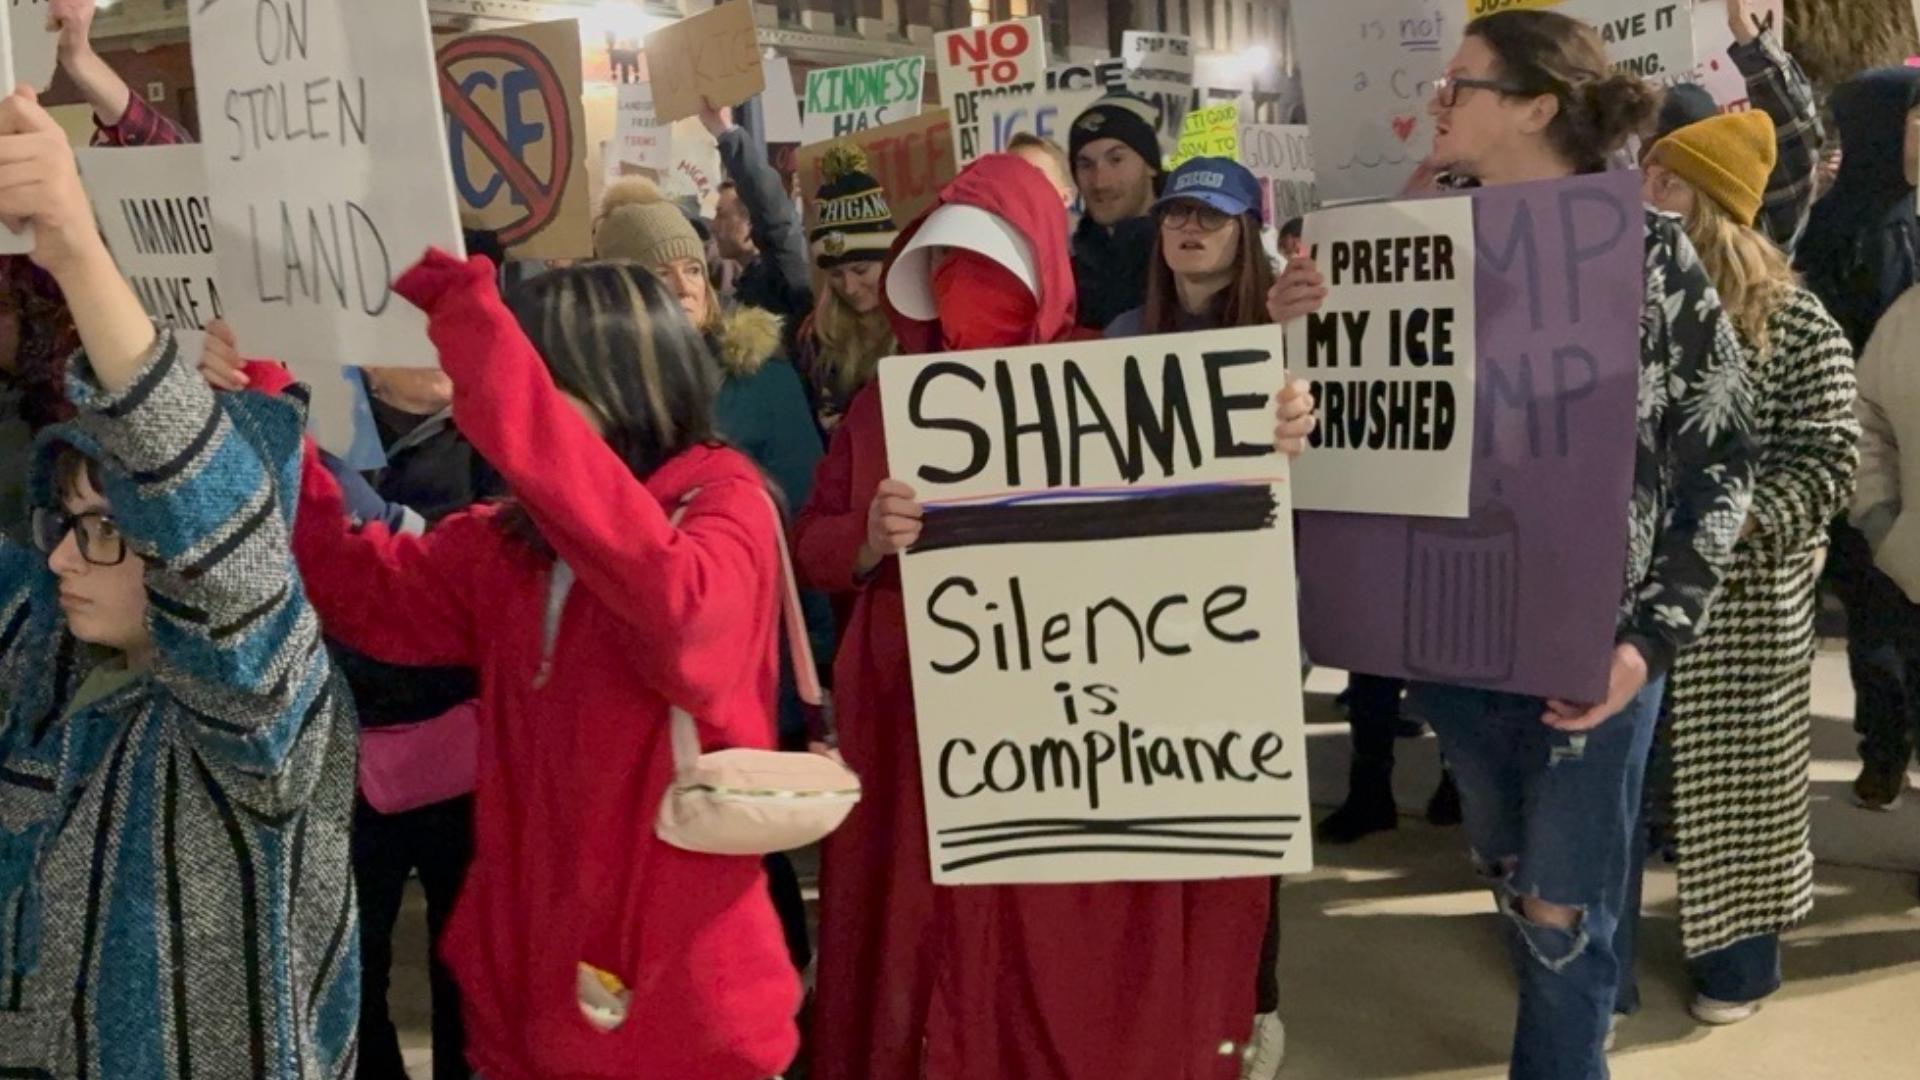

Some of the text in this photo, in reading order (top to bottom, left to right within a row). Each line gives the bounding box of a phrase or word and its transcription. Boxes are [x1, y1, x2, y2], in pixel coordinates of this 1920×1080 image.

[255, 0, 308, 65] ON
[946, 24, 1029, 66] NO
[1401, 10, 1443, 39] not
[1593, 5, 1677, 43] AVE IT
[807, 58, 922, 113] KINDNESS
[968, 60, 1019, 87] TO
[223, 77, 367, 161] STOLEN
[249, 200, 392, 317] LAND
[1331, 234, 1455, 286] PREFER
[1306, 308, 1455, 368] MY ICE
[907, 349, 1277, 487] SHAME
[1306, 380, 1456, 451] CRUSHED
[926, 576, 1261, 675] Silence
[1053, 682, 1118, 725] is
